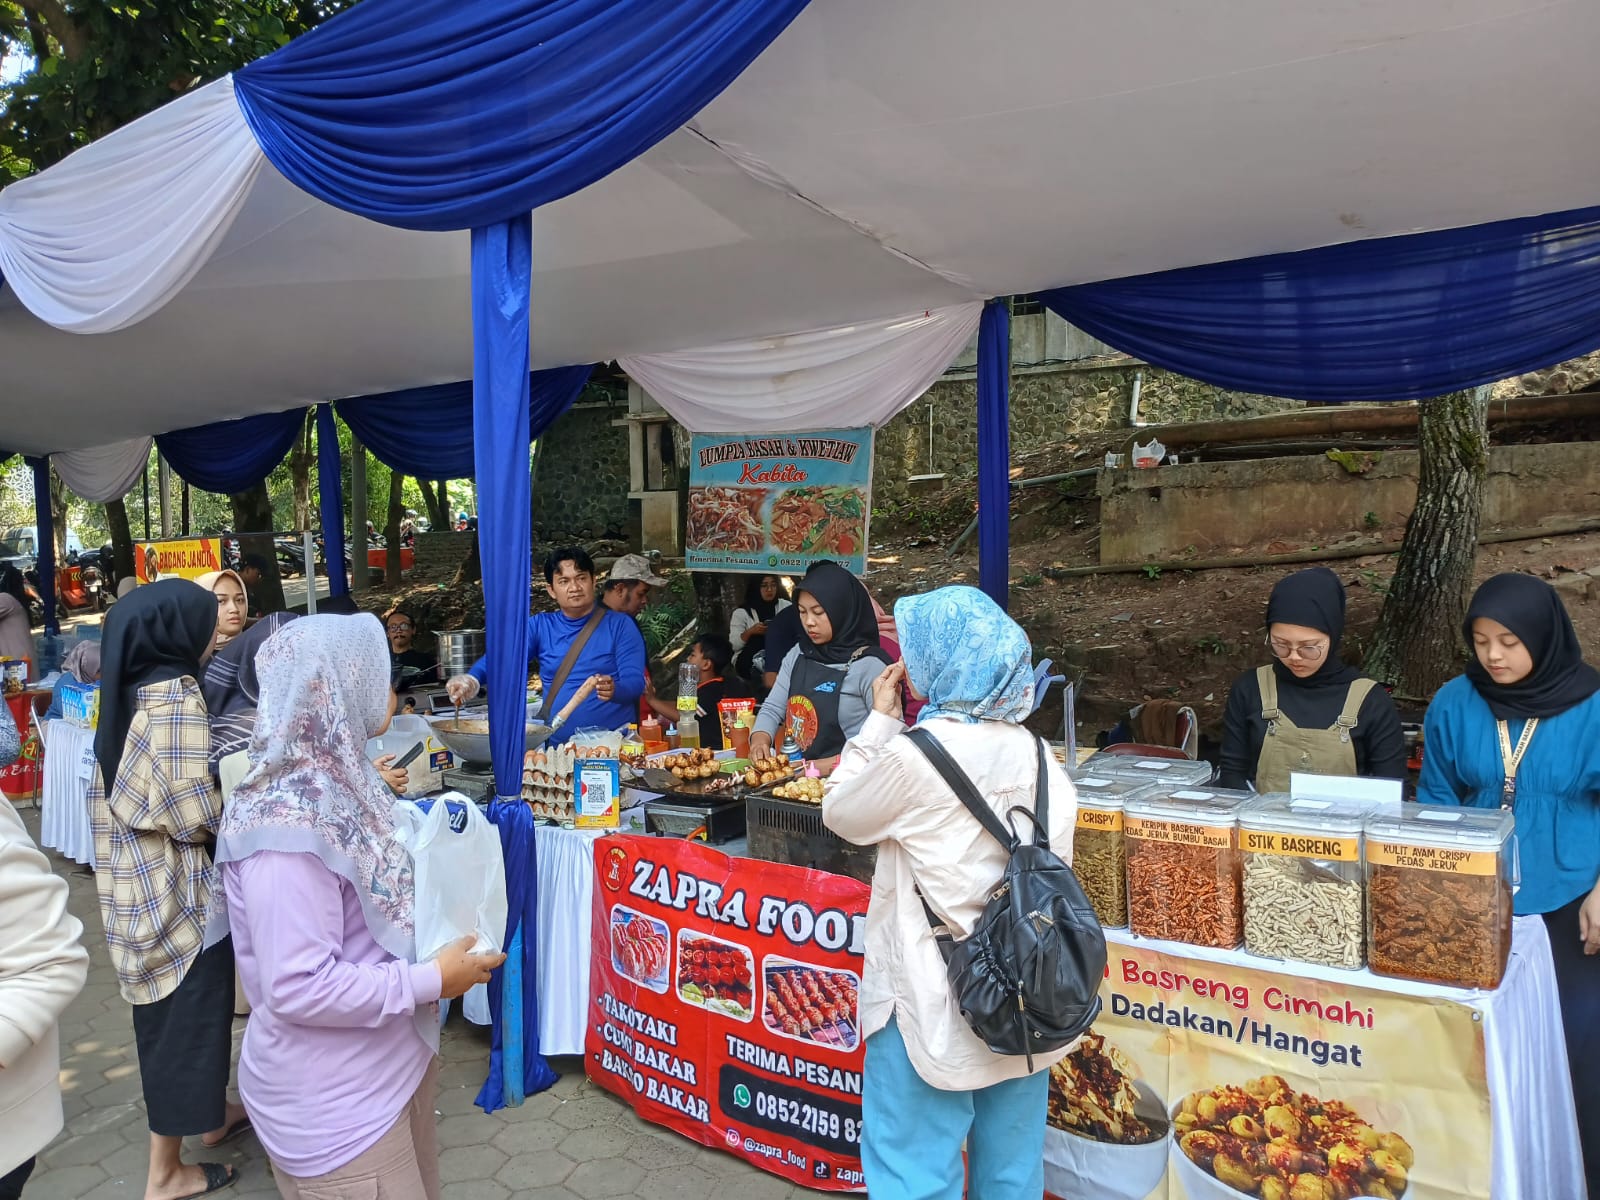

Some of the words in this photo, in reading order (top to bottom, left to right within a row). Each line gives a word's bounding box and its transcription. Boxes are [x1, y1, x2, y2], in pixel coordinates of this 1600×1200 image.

[700, 441, 745, 467] LUMPIA
[745, 439, 784, 459] BASAH
[786, 440, 797, 457] &
[798, 439, 858, 464] KWETIAW
[738, 463, 808, 484] Kabita
[725, 556, 759, 565] Pesanan
[780, 558, 801, 566] 0822
[1082, 812, 1115, 826] CRISPY
[1141, 819, 1168, 831] KERIPIK
[1170, 823, 1205, 836] BASRENG
[1146, 829, 1170, 841] JERUK
[1172, 832, 1200, 844] BUMBU
[1203, 836, 1228, 846] BASAH
[1248, 834, 1275, 850] STIK
[1281, 837, 1342, 857] BASRENG
[1383, 844, 1409, 856] KULIT
[1412, 847, 1436, 859] AYAM
[1439, 849, 1472, 862] CRISPY
[1396, 855, 1425, 868] PEDAS
[1428, 859, 1458, 871] JERUK
[627, 858, 751, 930] ZAPRA
[1121, 958, 1250, 1010] Basreng
[1263, 986, 1375, 1029] Cimahi
[603, 992, 678, 1047] TAKOYAKI
[1111, 992, 1363, 1068] Dadakan/Hangat
[602, 1021, 633, 1057] CUMI
[634, 1040, 698, 1086] BAKAR
[725, 1034, 792, 1078] TERIMA
[794, 1057, 863, 1096] PESAN
[601, 1048, 645, 1093] BAKSO
[645, 1076, 711, 1123] BAKAR
[743, 1136, 806, 1170] @zapra_food
